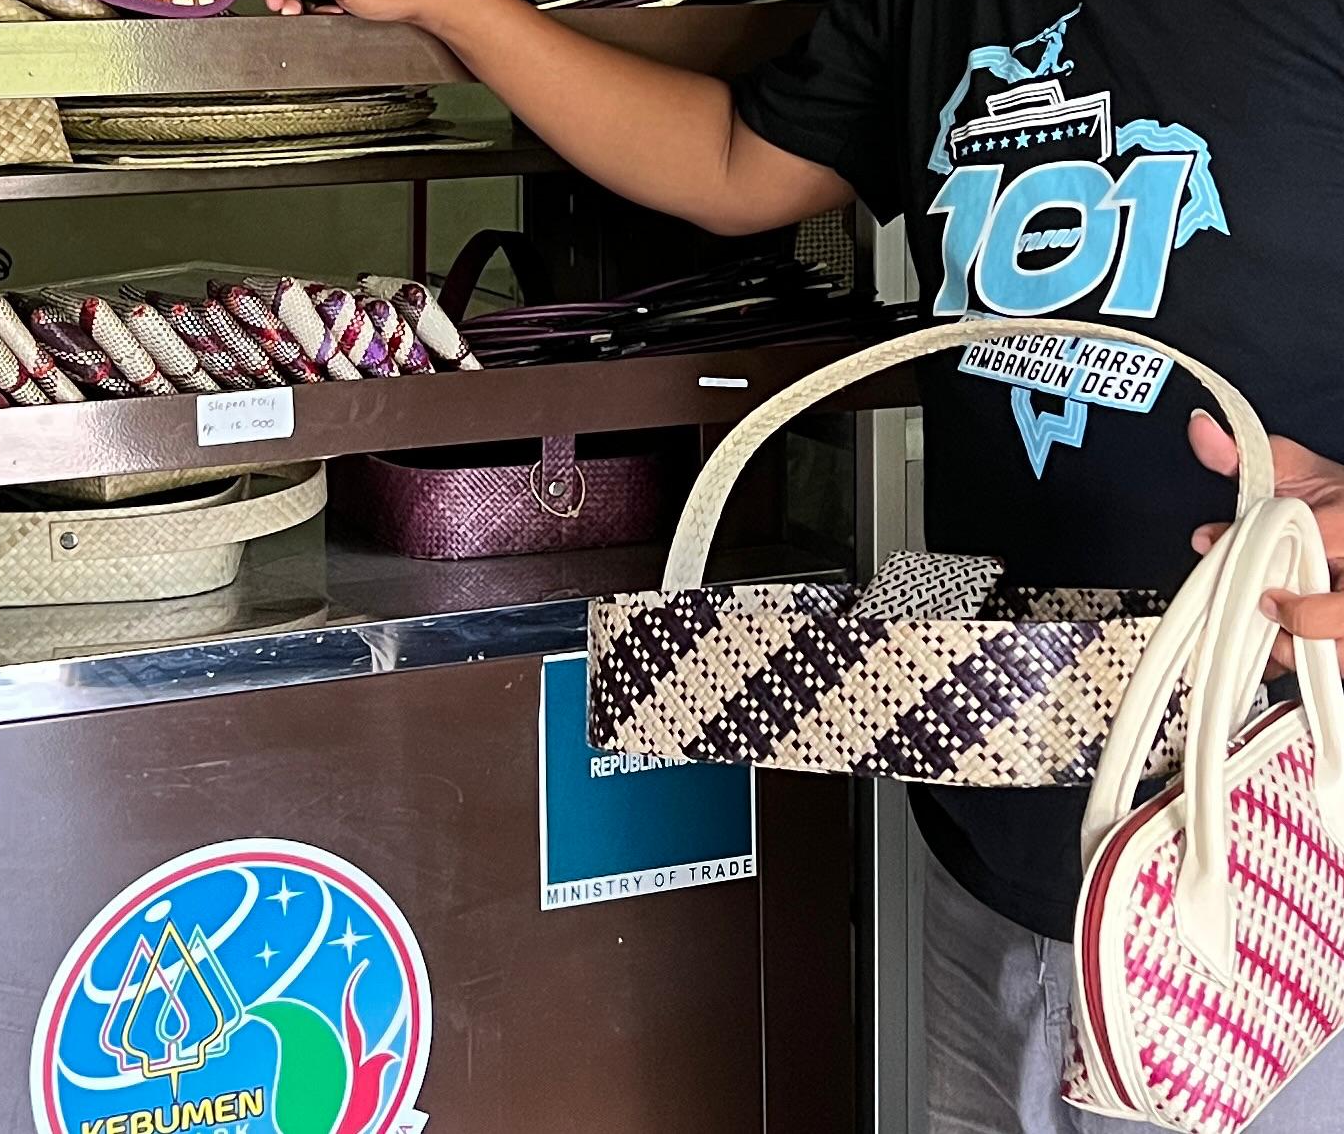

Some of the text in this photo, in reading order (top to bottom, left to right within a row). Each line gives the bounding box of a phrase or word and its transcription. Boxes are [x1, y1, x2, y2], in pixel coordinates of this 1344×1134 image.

[927, 154, 1195, 318] 101
[1076, 343, 1164, 379] KARSA
[1080, 371, 1153, 404] DESA
[590, 753, 663, 779] REPUBLIK
[546, 858, 753, 906] MINISTRY OF TRADE
[80, 1086, 265, 1134] KEBUMEN
